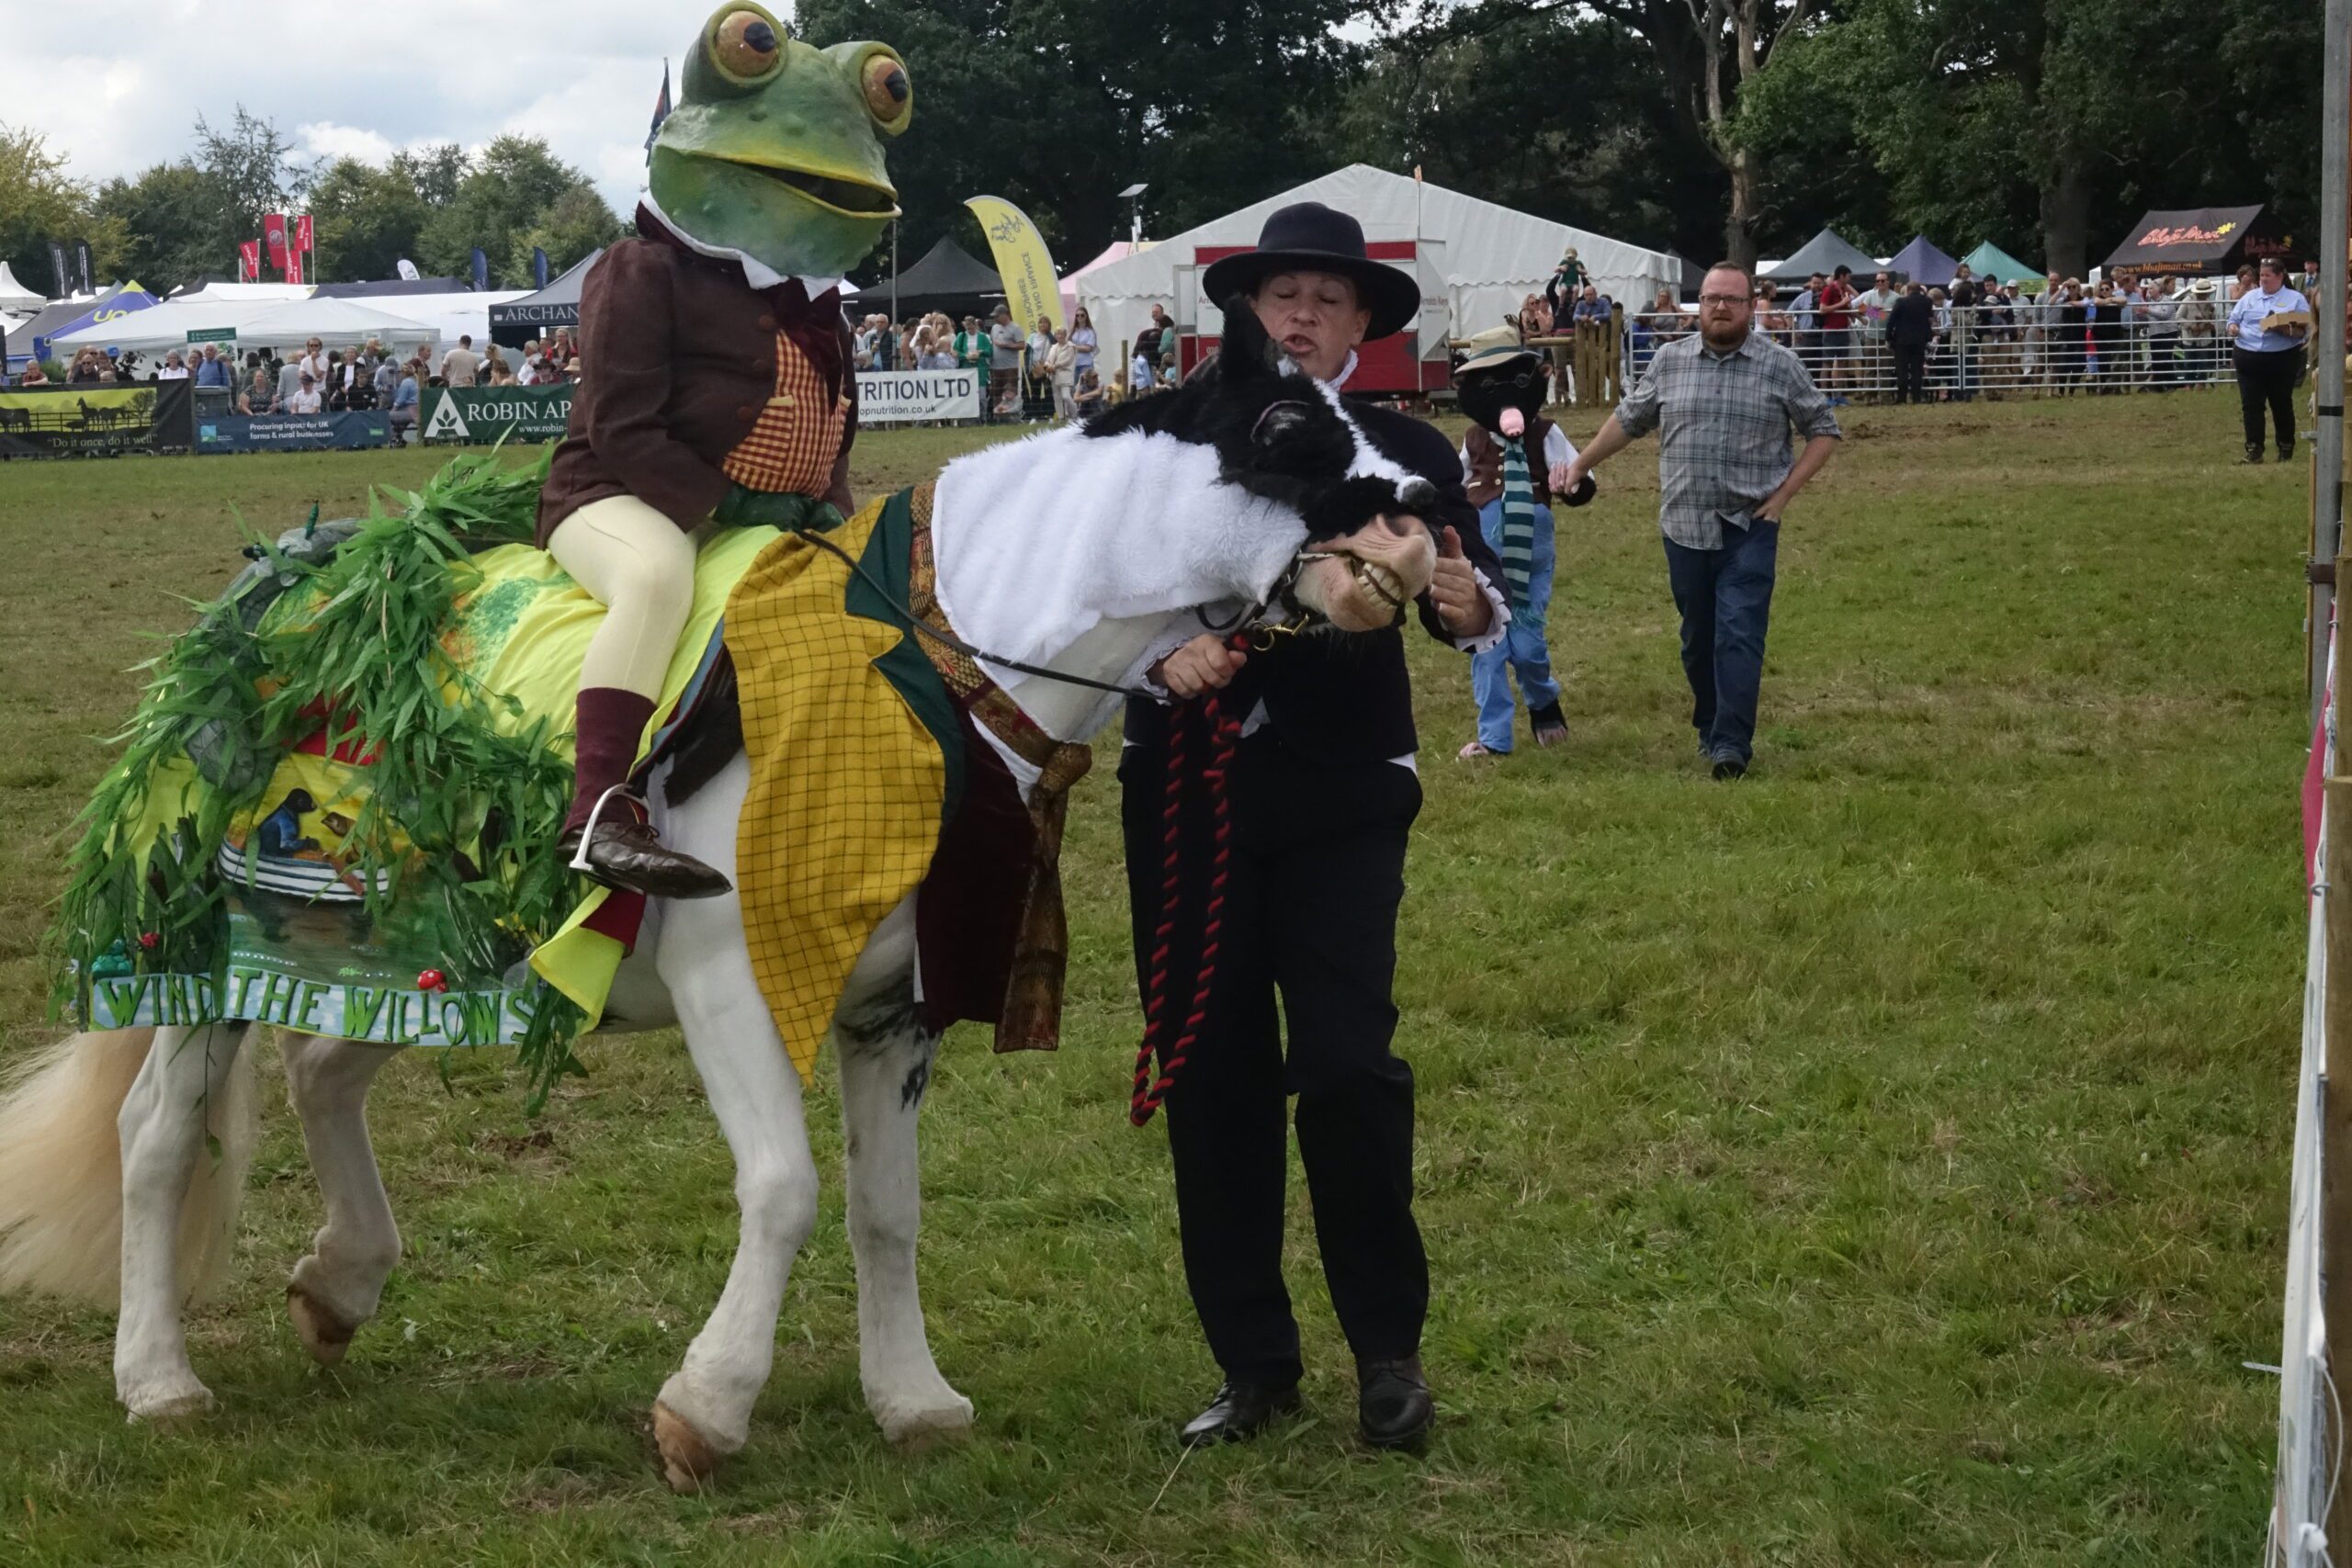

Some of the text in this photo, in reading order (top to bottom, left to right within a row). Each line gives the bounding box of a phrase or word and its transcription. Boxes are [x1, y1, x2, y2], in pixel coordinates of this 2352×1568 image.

[934, 378, 971, 398] LTD
[467, 401, 538, 422] ROBIN
[249, 423, 283, 432] Procuring
[306, 421, 316, 429] for
[250, 430, 334, 440] farms & rural businesses
[71, 438, 77, 447] it
[80, 438, 106, 448] once,
[107, 436, 120, 446] do
[123, 434, 130, 445] it
[98, 967, 536, 1045] WIND THE WILLOWS
